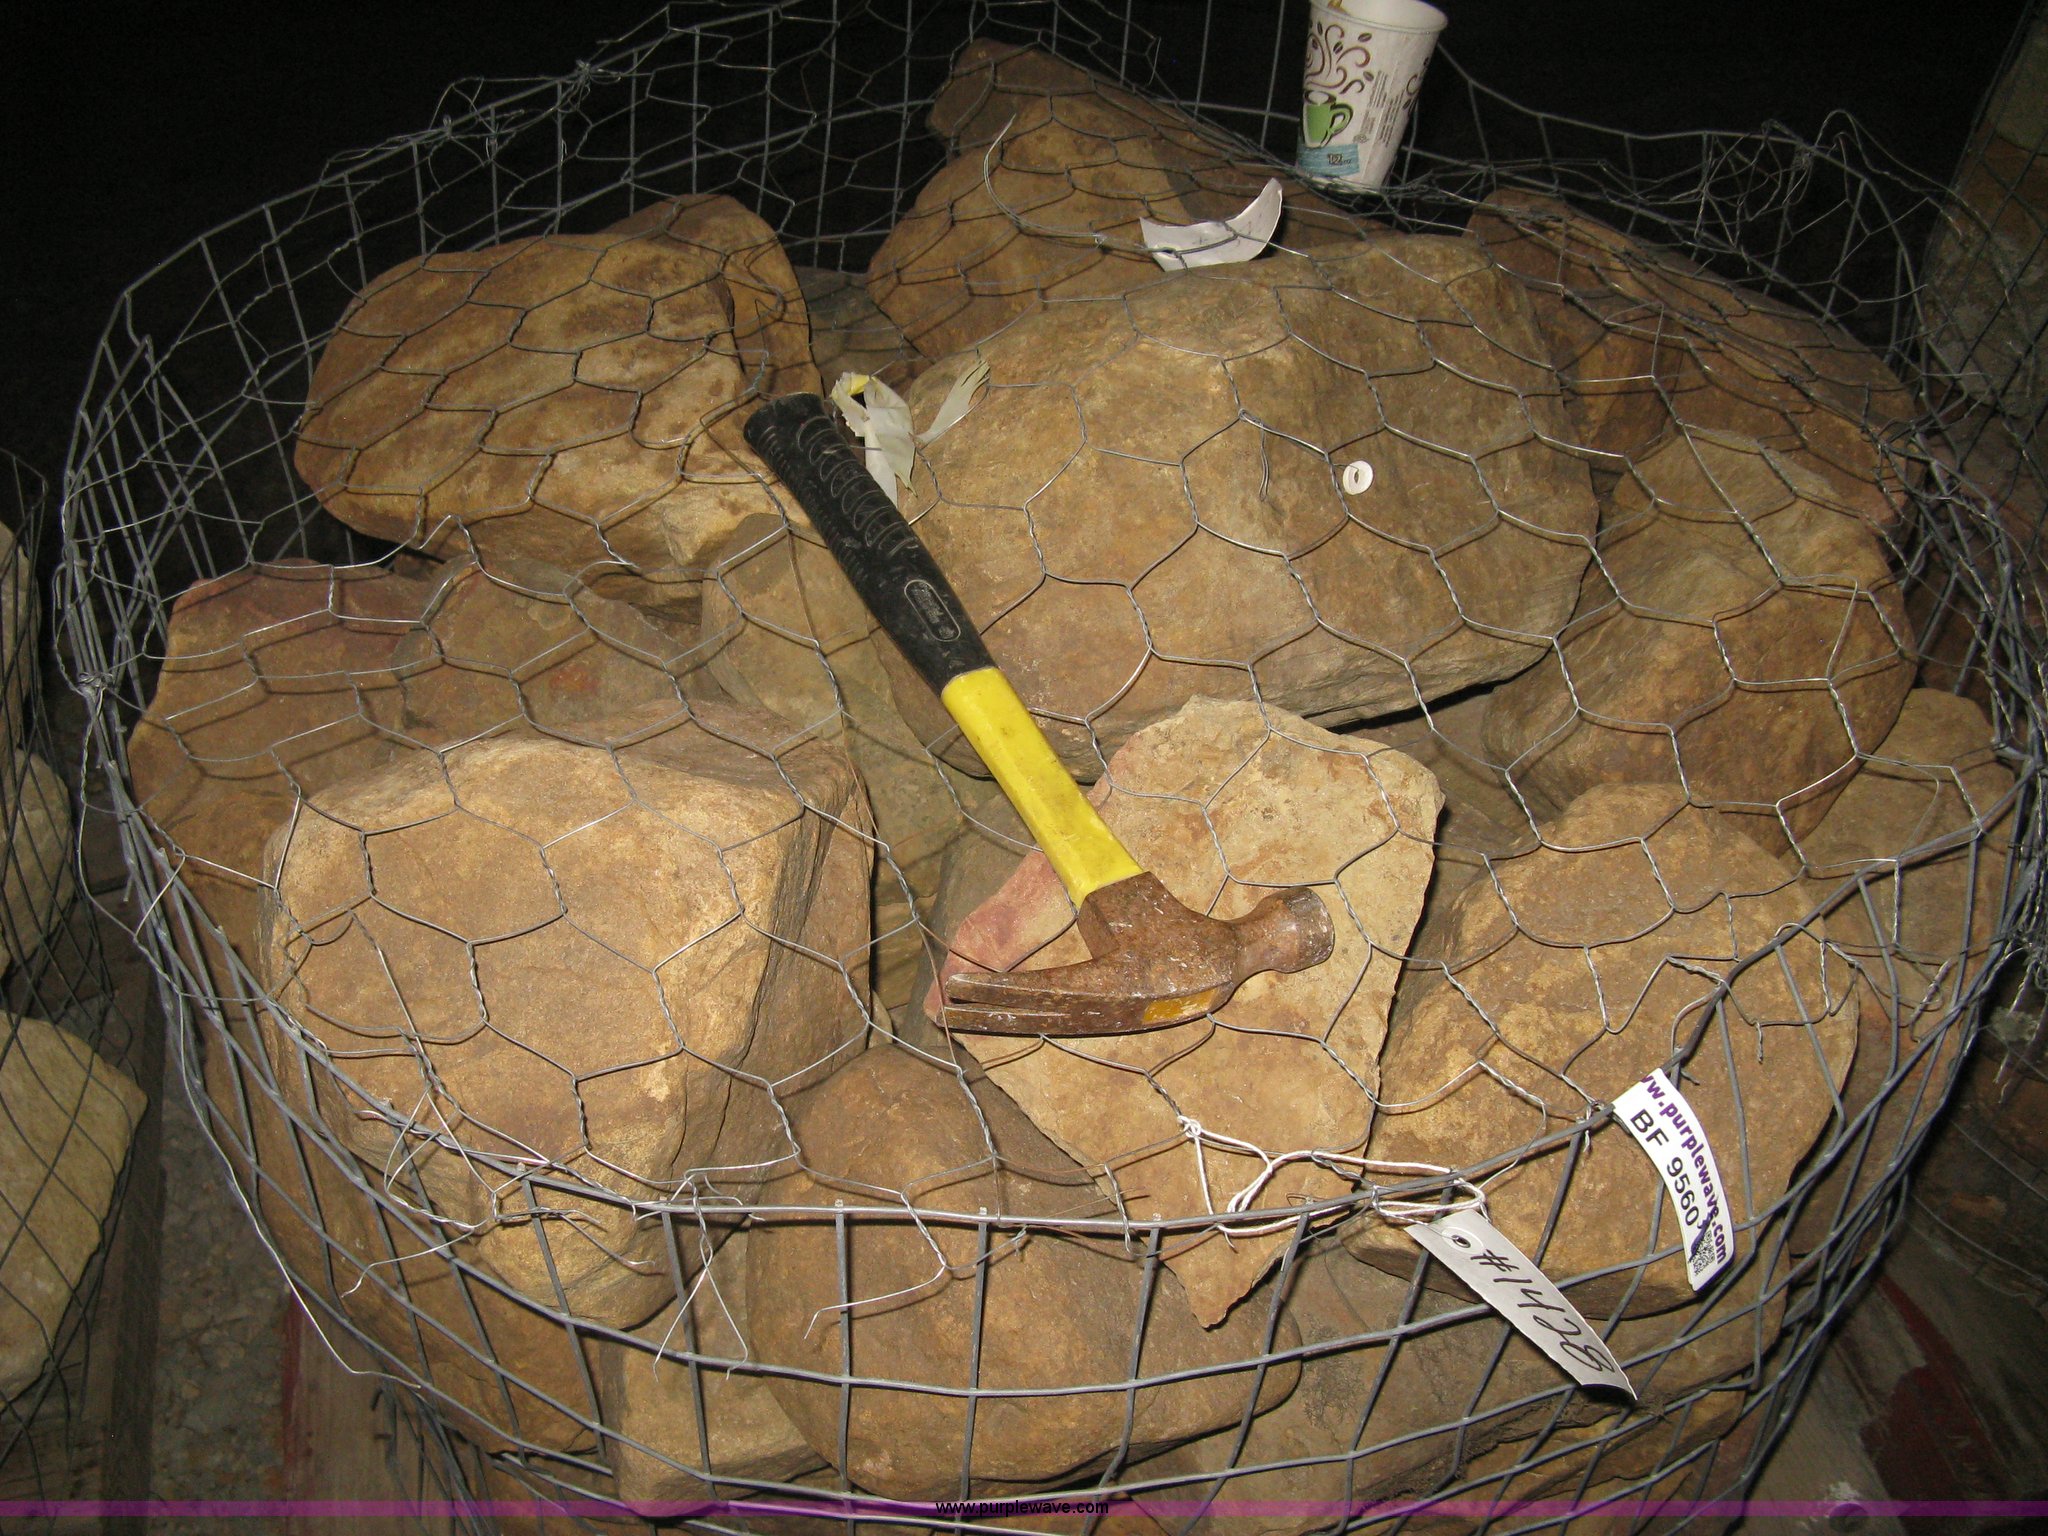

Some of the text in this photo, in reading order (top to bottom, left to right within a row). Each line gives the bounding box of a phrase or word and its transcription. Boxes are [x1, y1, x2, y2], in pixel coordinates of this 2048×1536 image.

[1630, 1108, 1699, 1226] BF 9560
[1470, 1249, 1615, 1372] #1428
